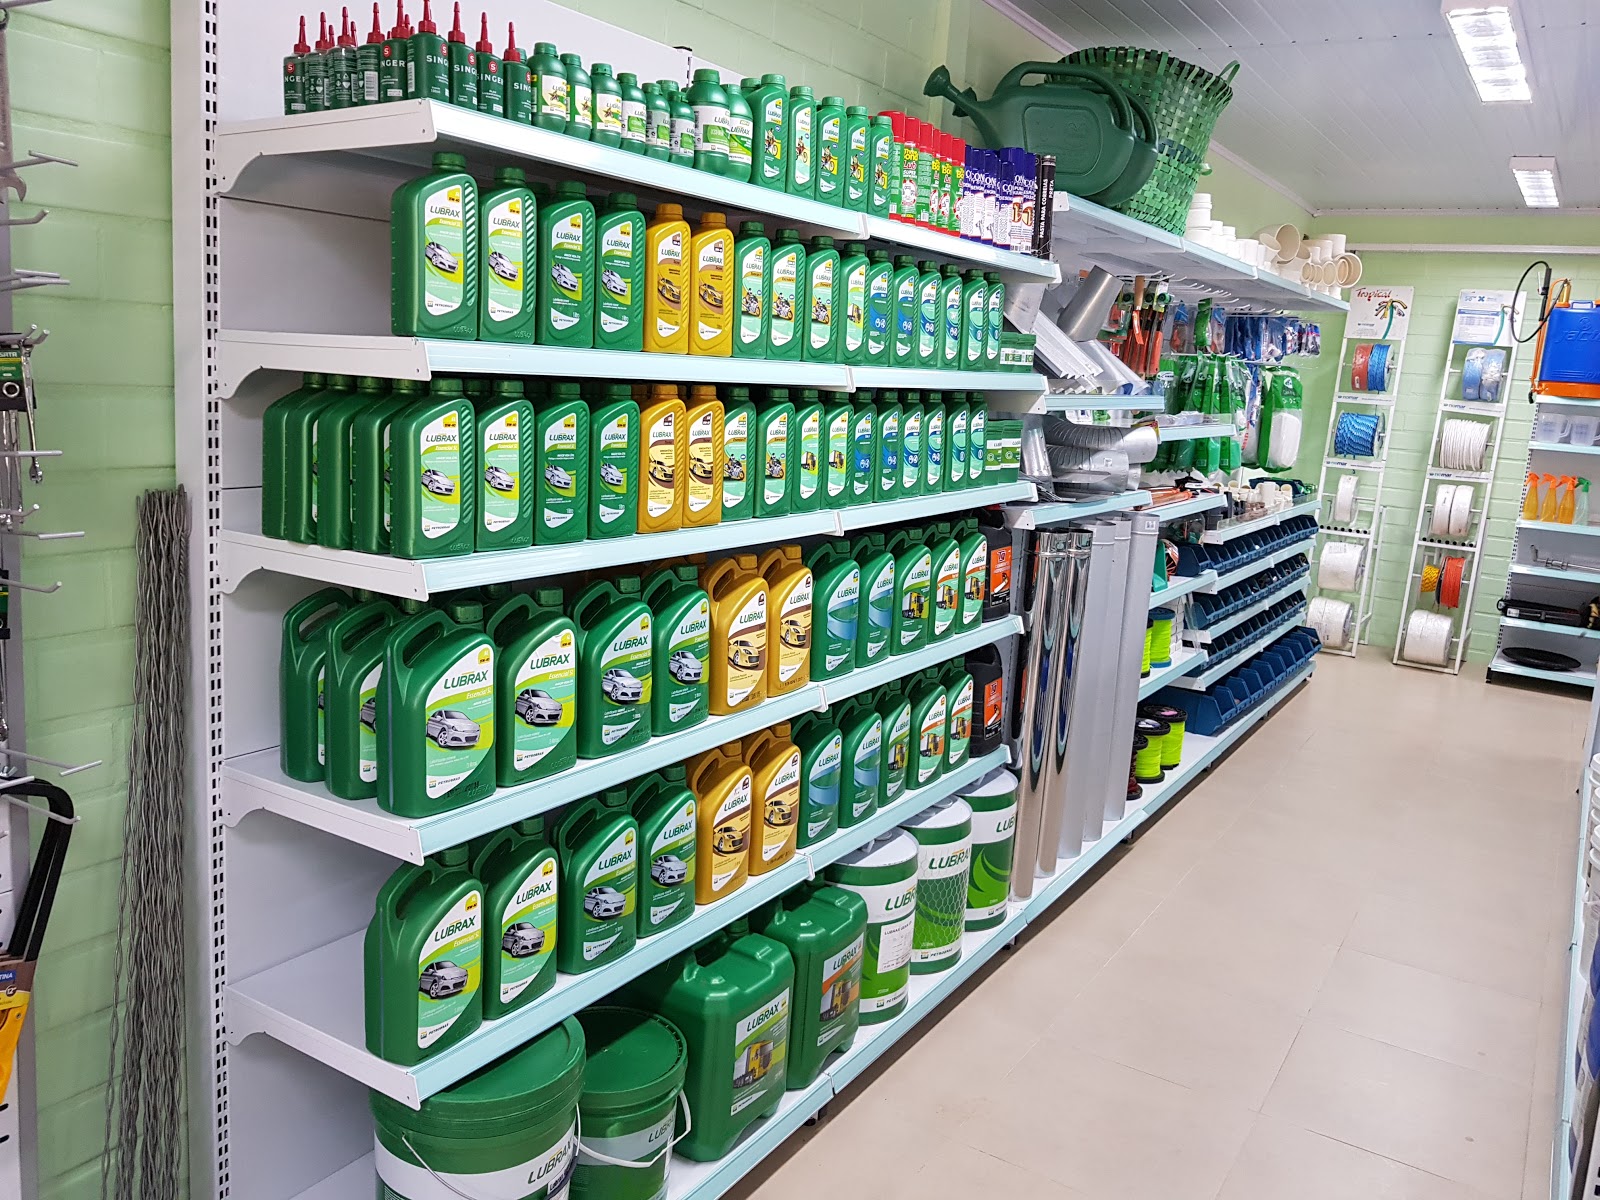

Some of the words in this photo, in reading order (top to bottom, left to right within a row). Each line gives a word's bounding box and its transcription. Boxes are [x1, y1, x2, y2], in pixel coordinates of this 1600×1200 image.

[381, 59, 406, 67] NGER
[426, 54, 448, 65] SING
[454, 64, 477, 74] SING
[513, 82, 531, 92] SING
[430, 205, 461, 218] LUBRAX
[493, 217, 520, 228] LUBRAX
[556, 231, 580, 242] LUBRAX
[607, 239, 630, 249] LUBRAX
[661, 248, 680, 258] LUBRAX
[702, 255, 722, 264] LUBRAX
[1356, 287, 1392, 302] Tropical
[1555, 330, 1600, 344] Jact
[425, 434, 457, 443] LUBRAX
[489, 433, 518, 441] LUBRAX
[604, 433, 626, 441] LUBRAX
[911, 569, 929, 580] LUBRAX
[876, 577, 894, 589] LUBRAX
[789, 591, 810, 605] LUBRAX
[837, 586, 858, 599] LUBRAX
[739, 610, 764, 624] LUBRAX
[680, 619, 707, 635] LUBRAX
[613, 635, 649, 652] LUBRAX
[530, 653, 570, 670] LUBRAX
[443, 669, 489, 690] LUBRAX
[548, 671, 569, 680] Essencial
[466, 690, 486, 700] Essencial
[928, 710, 944, 721] LUBRAX
[895, 719, 909, 733] LUBRAX
[862, 736, 880, 750] LUBRAX
[818, 752, 840, 767] LUBRAX
[774, 769, 797, 786] LUBRAX
[723, 795, 748, 812] LUBRAX
[663, 820, 692, 840] LUBRAX
[996, 816, 1015, 833] LUB
[598, 849, 633, 870] LUBRAX
[516, 880, 552, 905] LUBRAX
[885, 886, 917, 911] LUBR
[434, 915, 476, 942] LUBRAX
[833, 945, 858, 971] LUBRAX
[746, 1001, 780, 1032] LUBRAX
